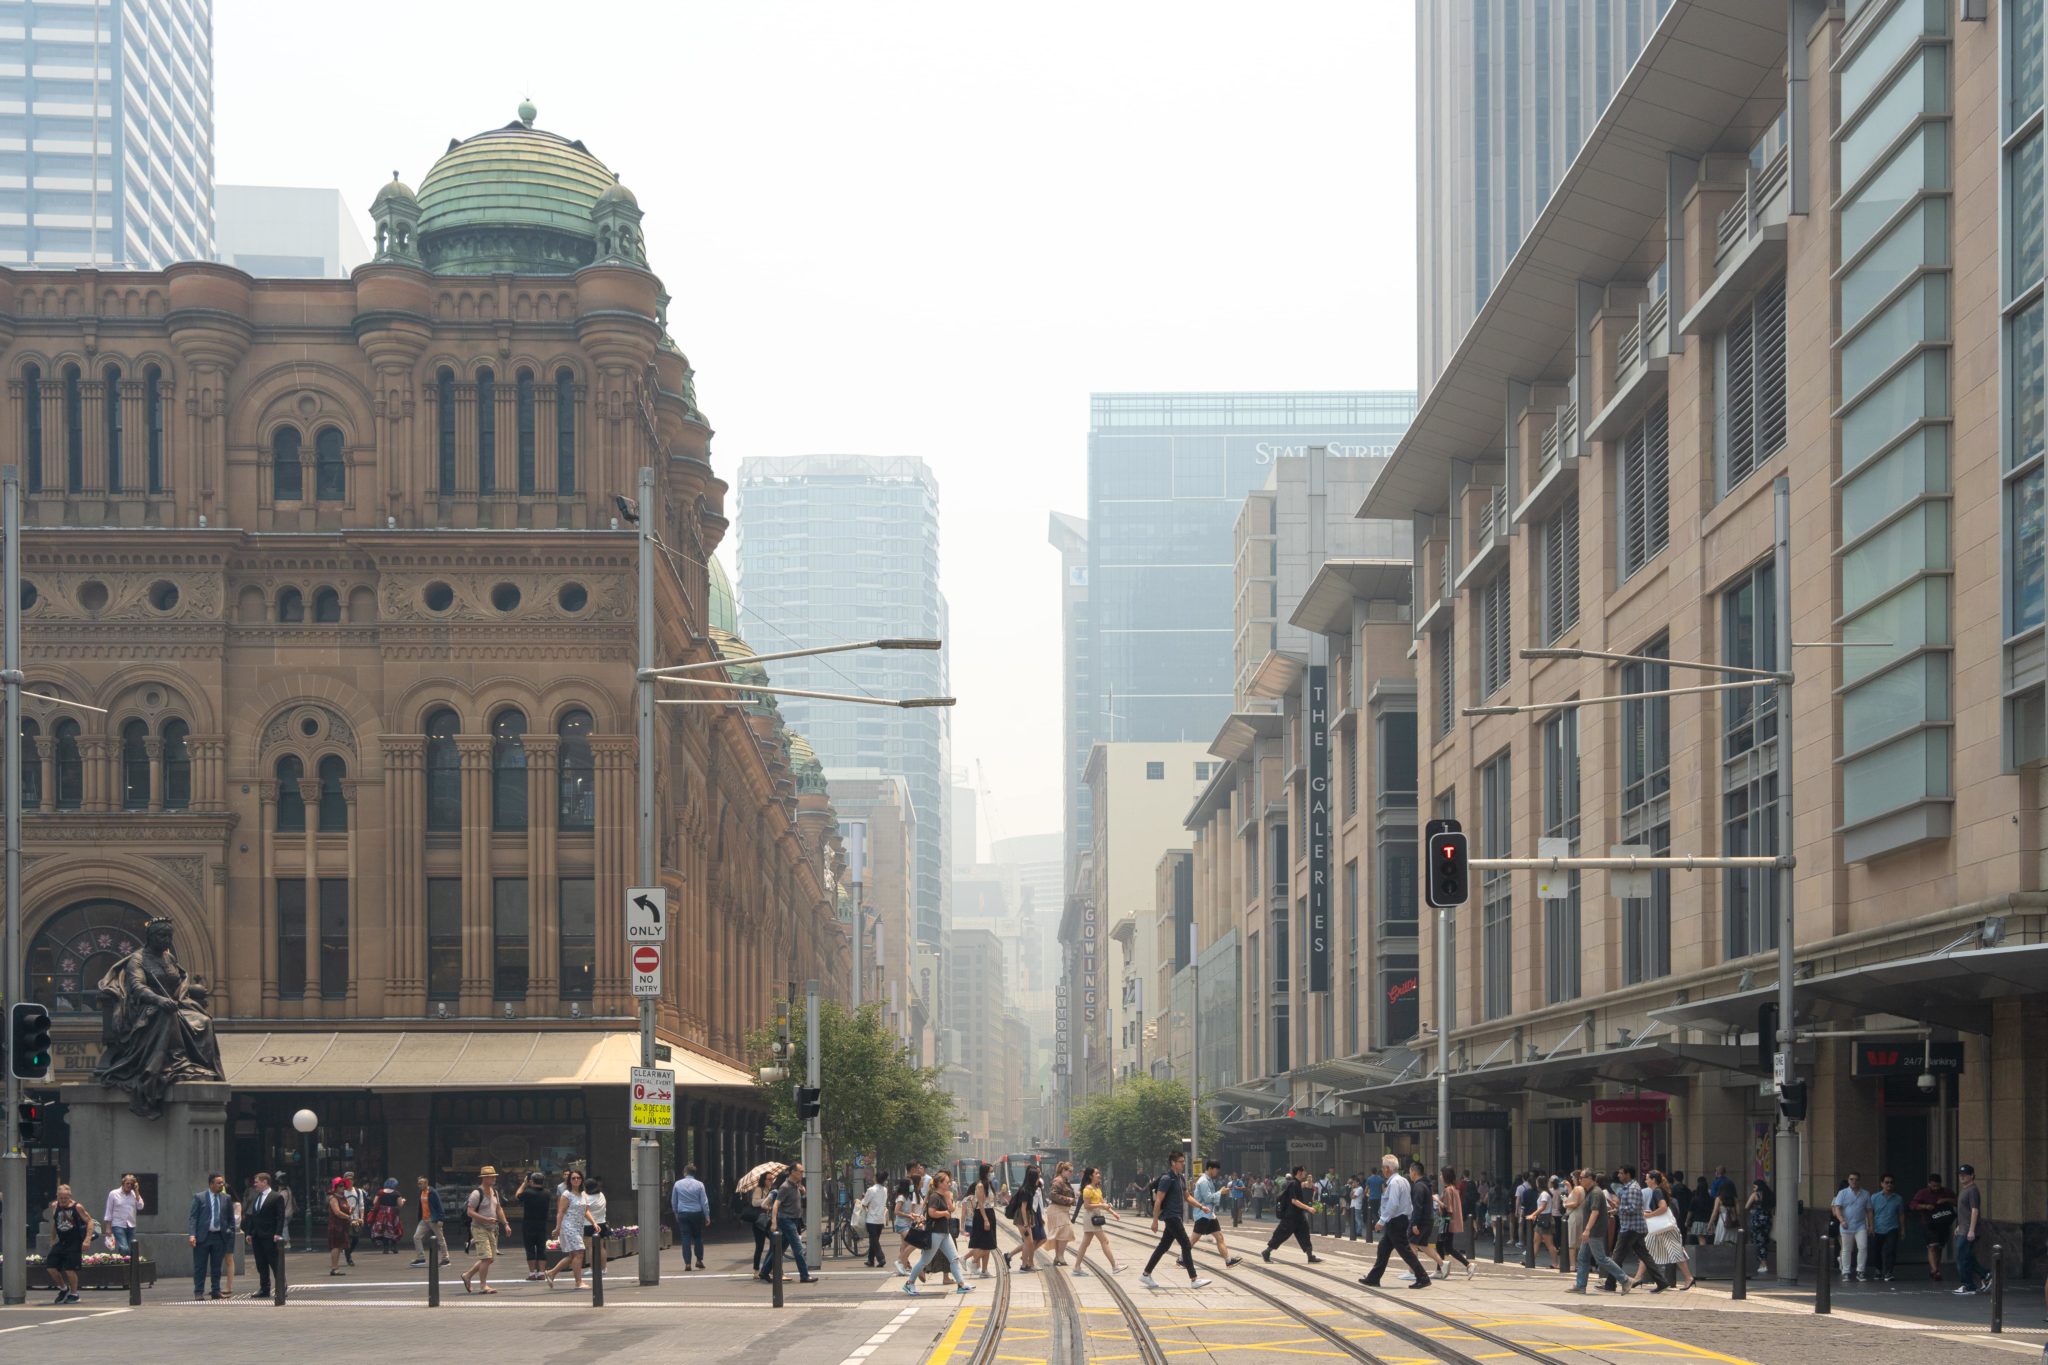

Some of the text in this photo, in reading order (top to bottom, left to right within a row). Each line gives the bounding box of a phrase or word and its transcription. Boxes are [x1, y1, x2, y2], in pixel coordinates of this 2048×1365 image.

[1255, 442, 1308, 464] STAT
[1311, 686, 1326, 952] THE GALERIES
[629, 926, 663, 936] ONLY
[1084, 908, 1096, 1021] GOWINGS
[639, 975, 654, 984] NO
[1058, 986, 1067, 1064] DYMOCKS
[259, 1055, 309, 1066] QVB
[1903, 1056, 1957, 1068] 24/7 anking
[633, 1069, 671, 1079] CLEARWAY
[649, 1104, 659, 1112] DEC
[646, 1116, 657, 1125] JAN
[658, 1117, 671, 1126] 2020
[1372, 1120, 1398, 1132] VAN
[1403, 1118, 1438, 1129] TEMP
